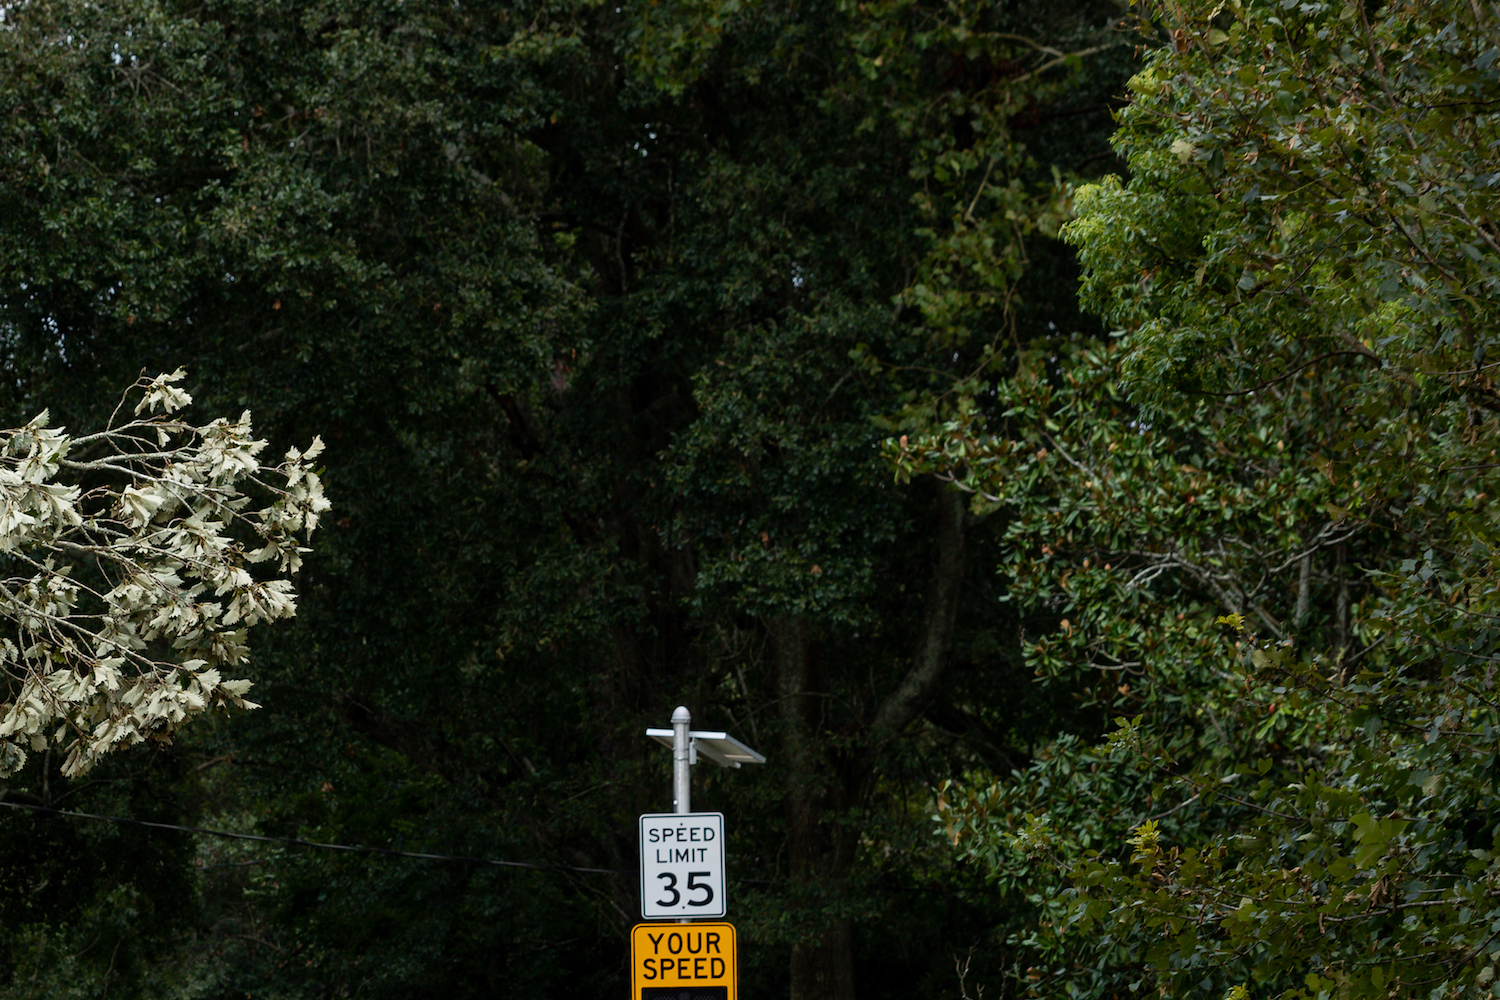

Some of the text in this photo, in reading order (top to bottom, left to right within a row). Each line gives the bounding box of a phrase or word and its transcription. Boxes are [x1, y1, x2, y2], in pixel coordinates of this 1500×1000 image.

[649, 827, 715, 842] SPEED
[656, 848, 708, 863] LIMIT
[656, 871, 714, 907] 35
[647, 932, 721, 955] YOUR
[643, 958, 726, 980] SPEED
